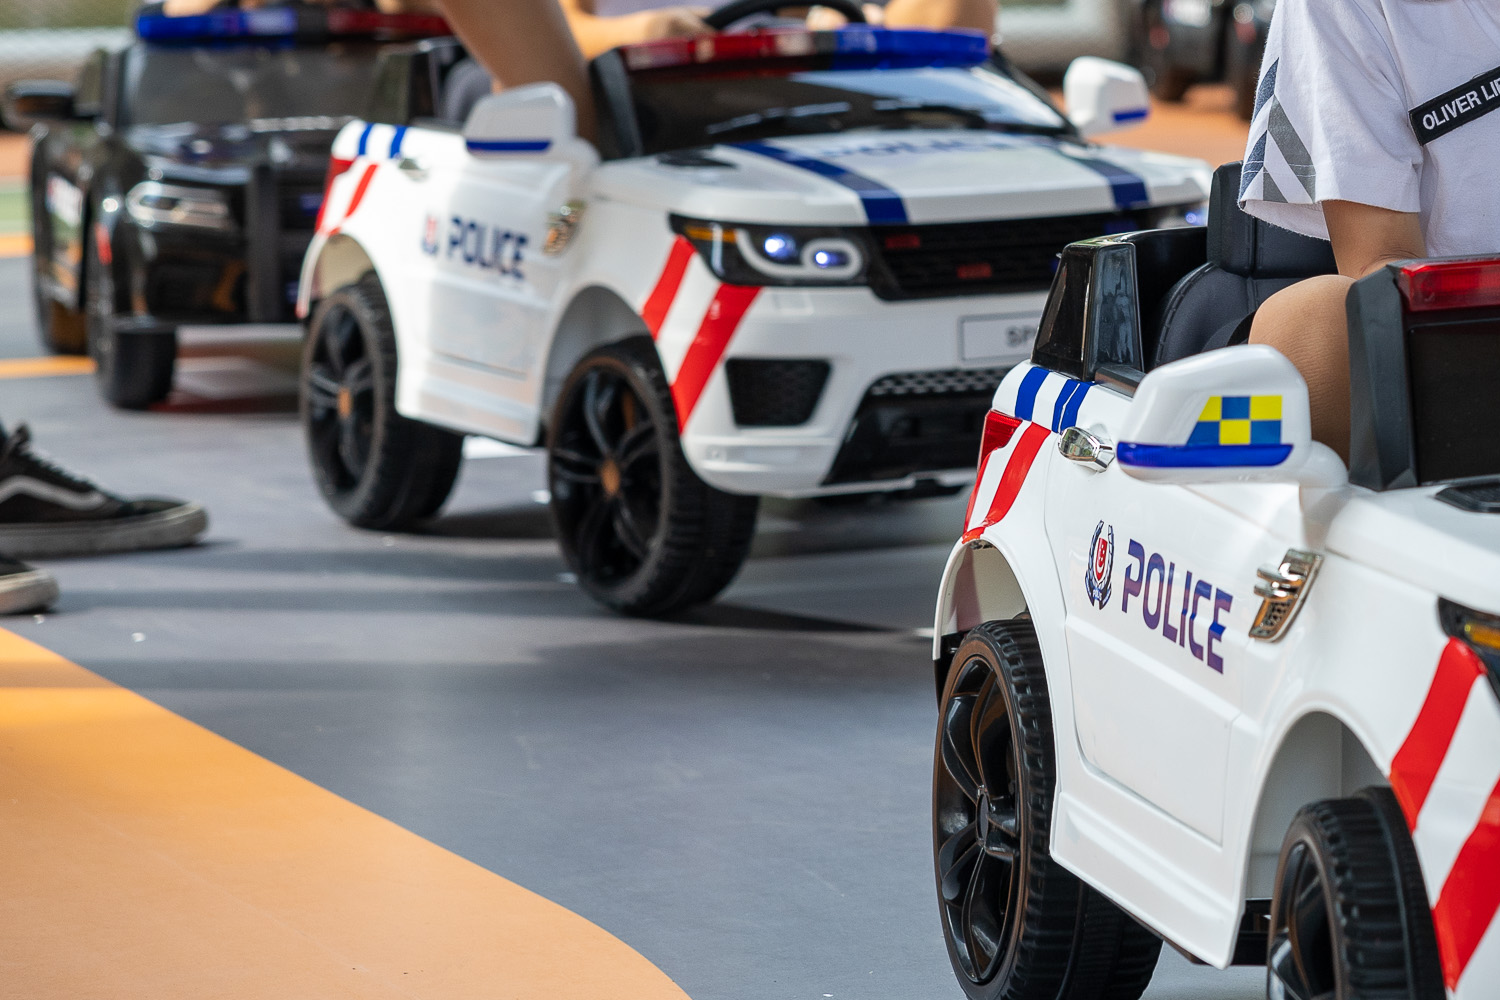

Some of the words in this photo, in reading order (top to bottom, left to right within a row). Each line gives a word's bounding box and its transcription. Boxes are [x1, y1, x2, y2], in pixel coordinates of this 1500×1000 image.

[1422, 90, 1481, 130] OLIVER
[450, 217, 529, 280] POLICE
[1121, 538, 1233, 675] POLICE
